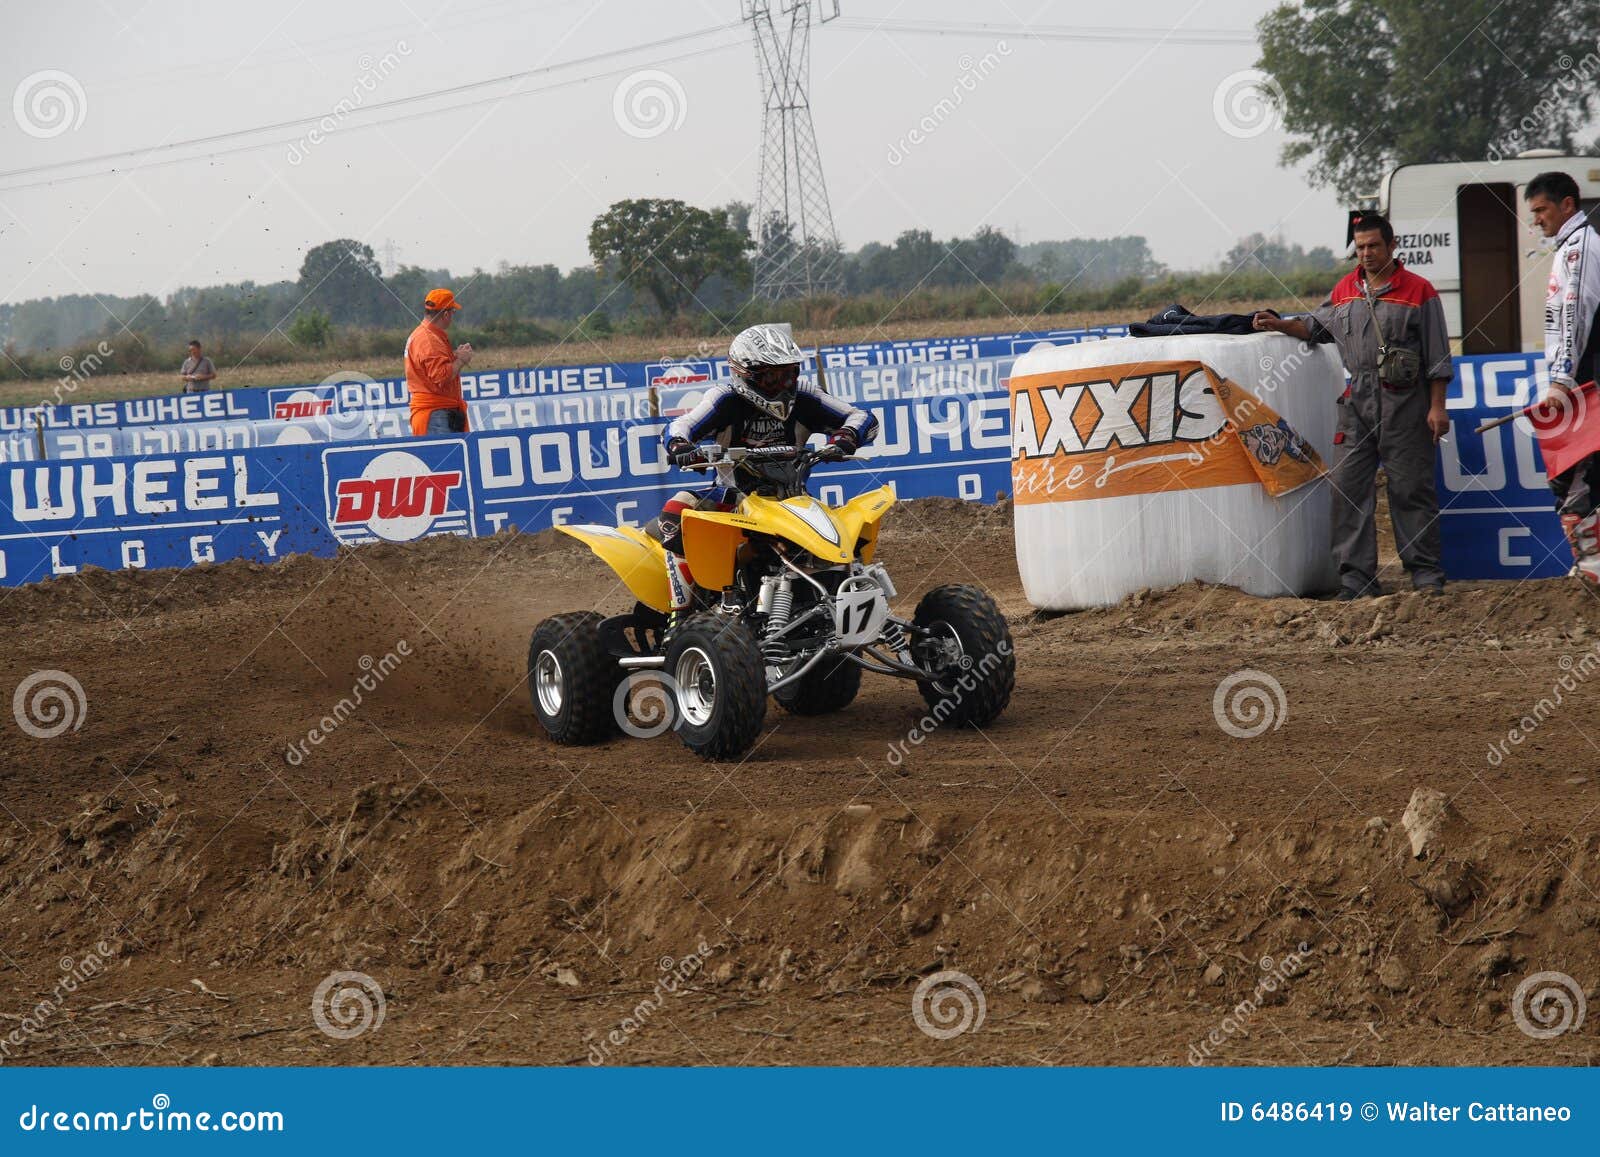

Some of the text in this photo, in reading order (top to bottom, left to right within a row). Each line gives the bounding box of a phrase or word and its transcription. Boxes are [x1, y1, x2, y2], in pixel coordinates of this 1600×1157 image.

[1394, 232, 1452, 249] REZIONE
[1397, 250, 1434, 266] GARA
[341, 366, 627, 408] DOUAS WHEEL
[125, 393, 249, 425] WHEEL
[1011, 367, 1231, 461] AXXIS
[10, 455, 279, 522] WHEEL
[335, 470, 462, 524] DWT
[0, 529, 282, 580] LOGY
[841, 597, 876, 636] 17
